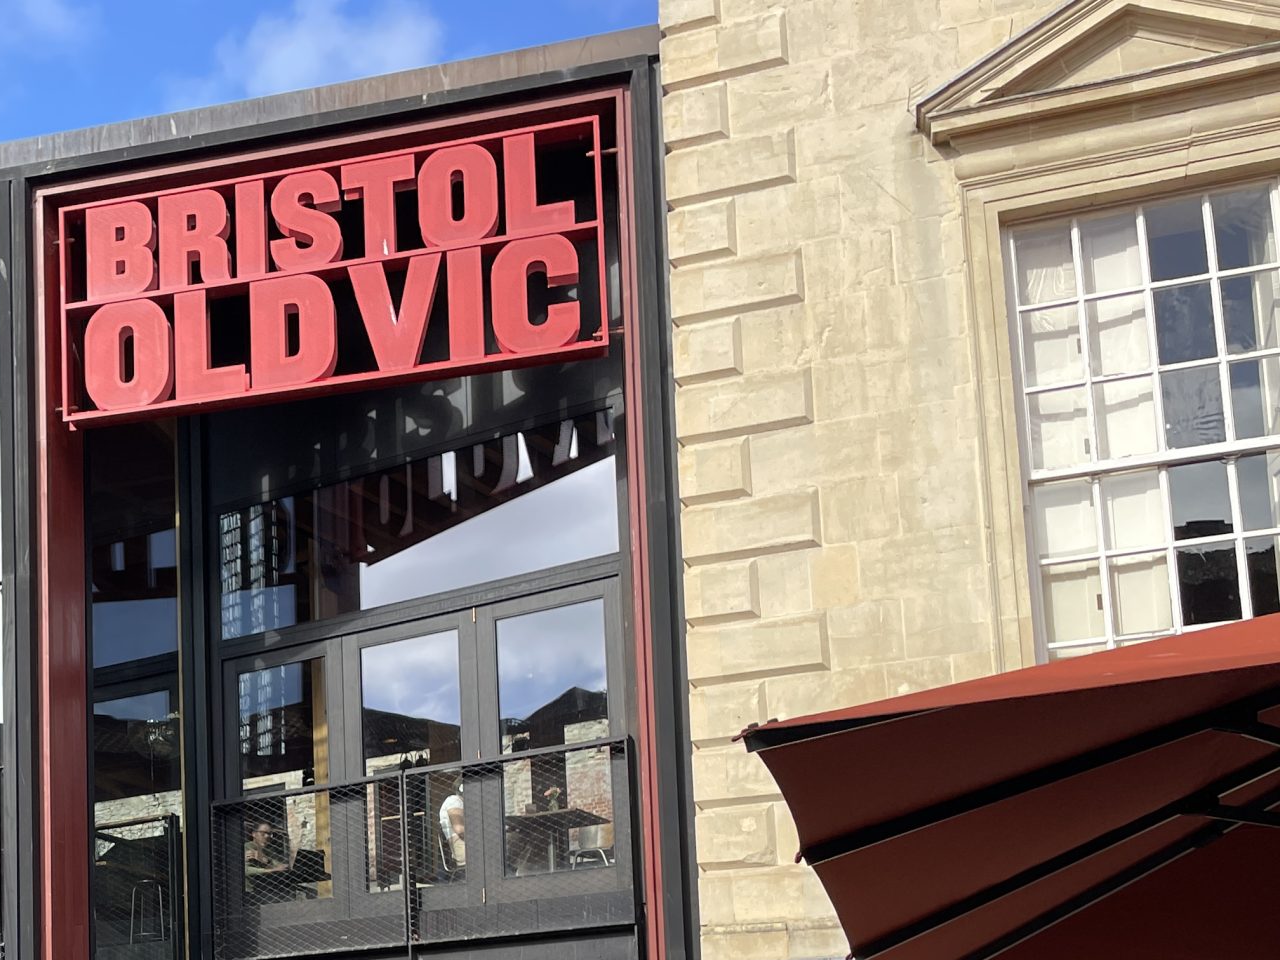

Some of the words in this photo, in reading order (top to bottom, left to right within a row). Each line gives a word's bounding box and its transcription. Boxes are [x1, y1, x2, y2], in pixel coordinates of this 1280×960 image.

[85, 131, 576, 301] BRISTOL
[84, 272, 337, 411] OLD
[347, 234, 582, 373] VIC
